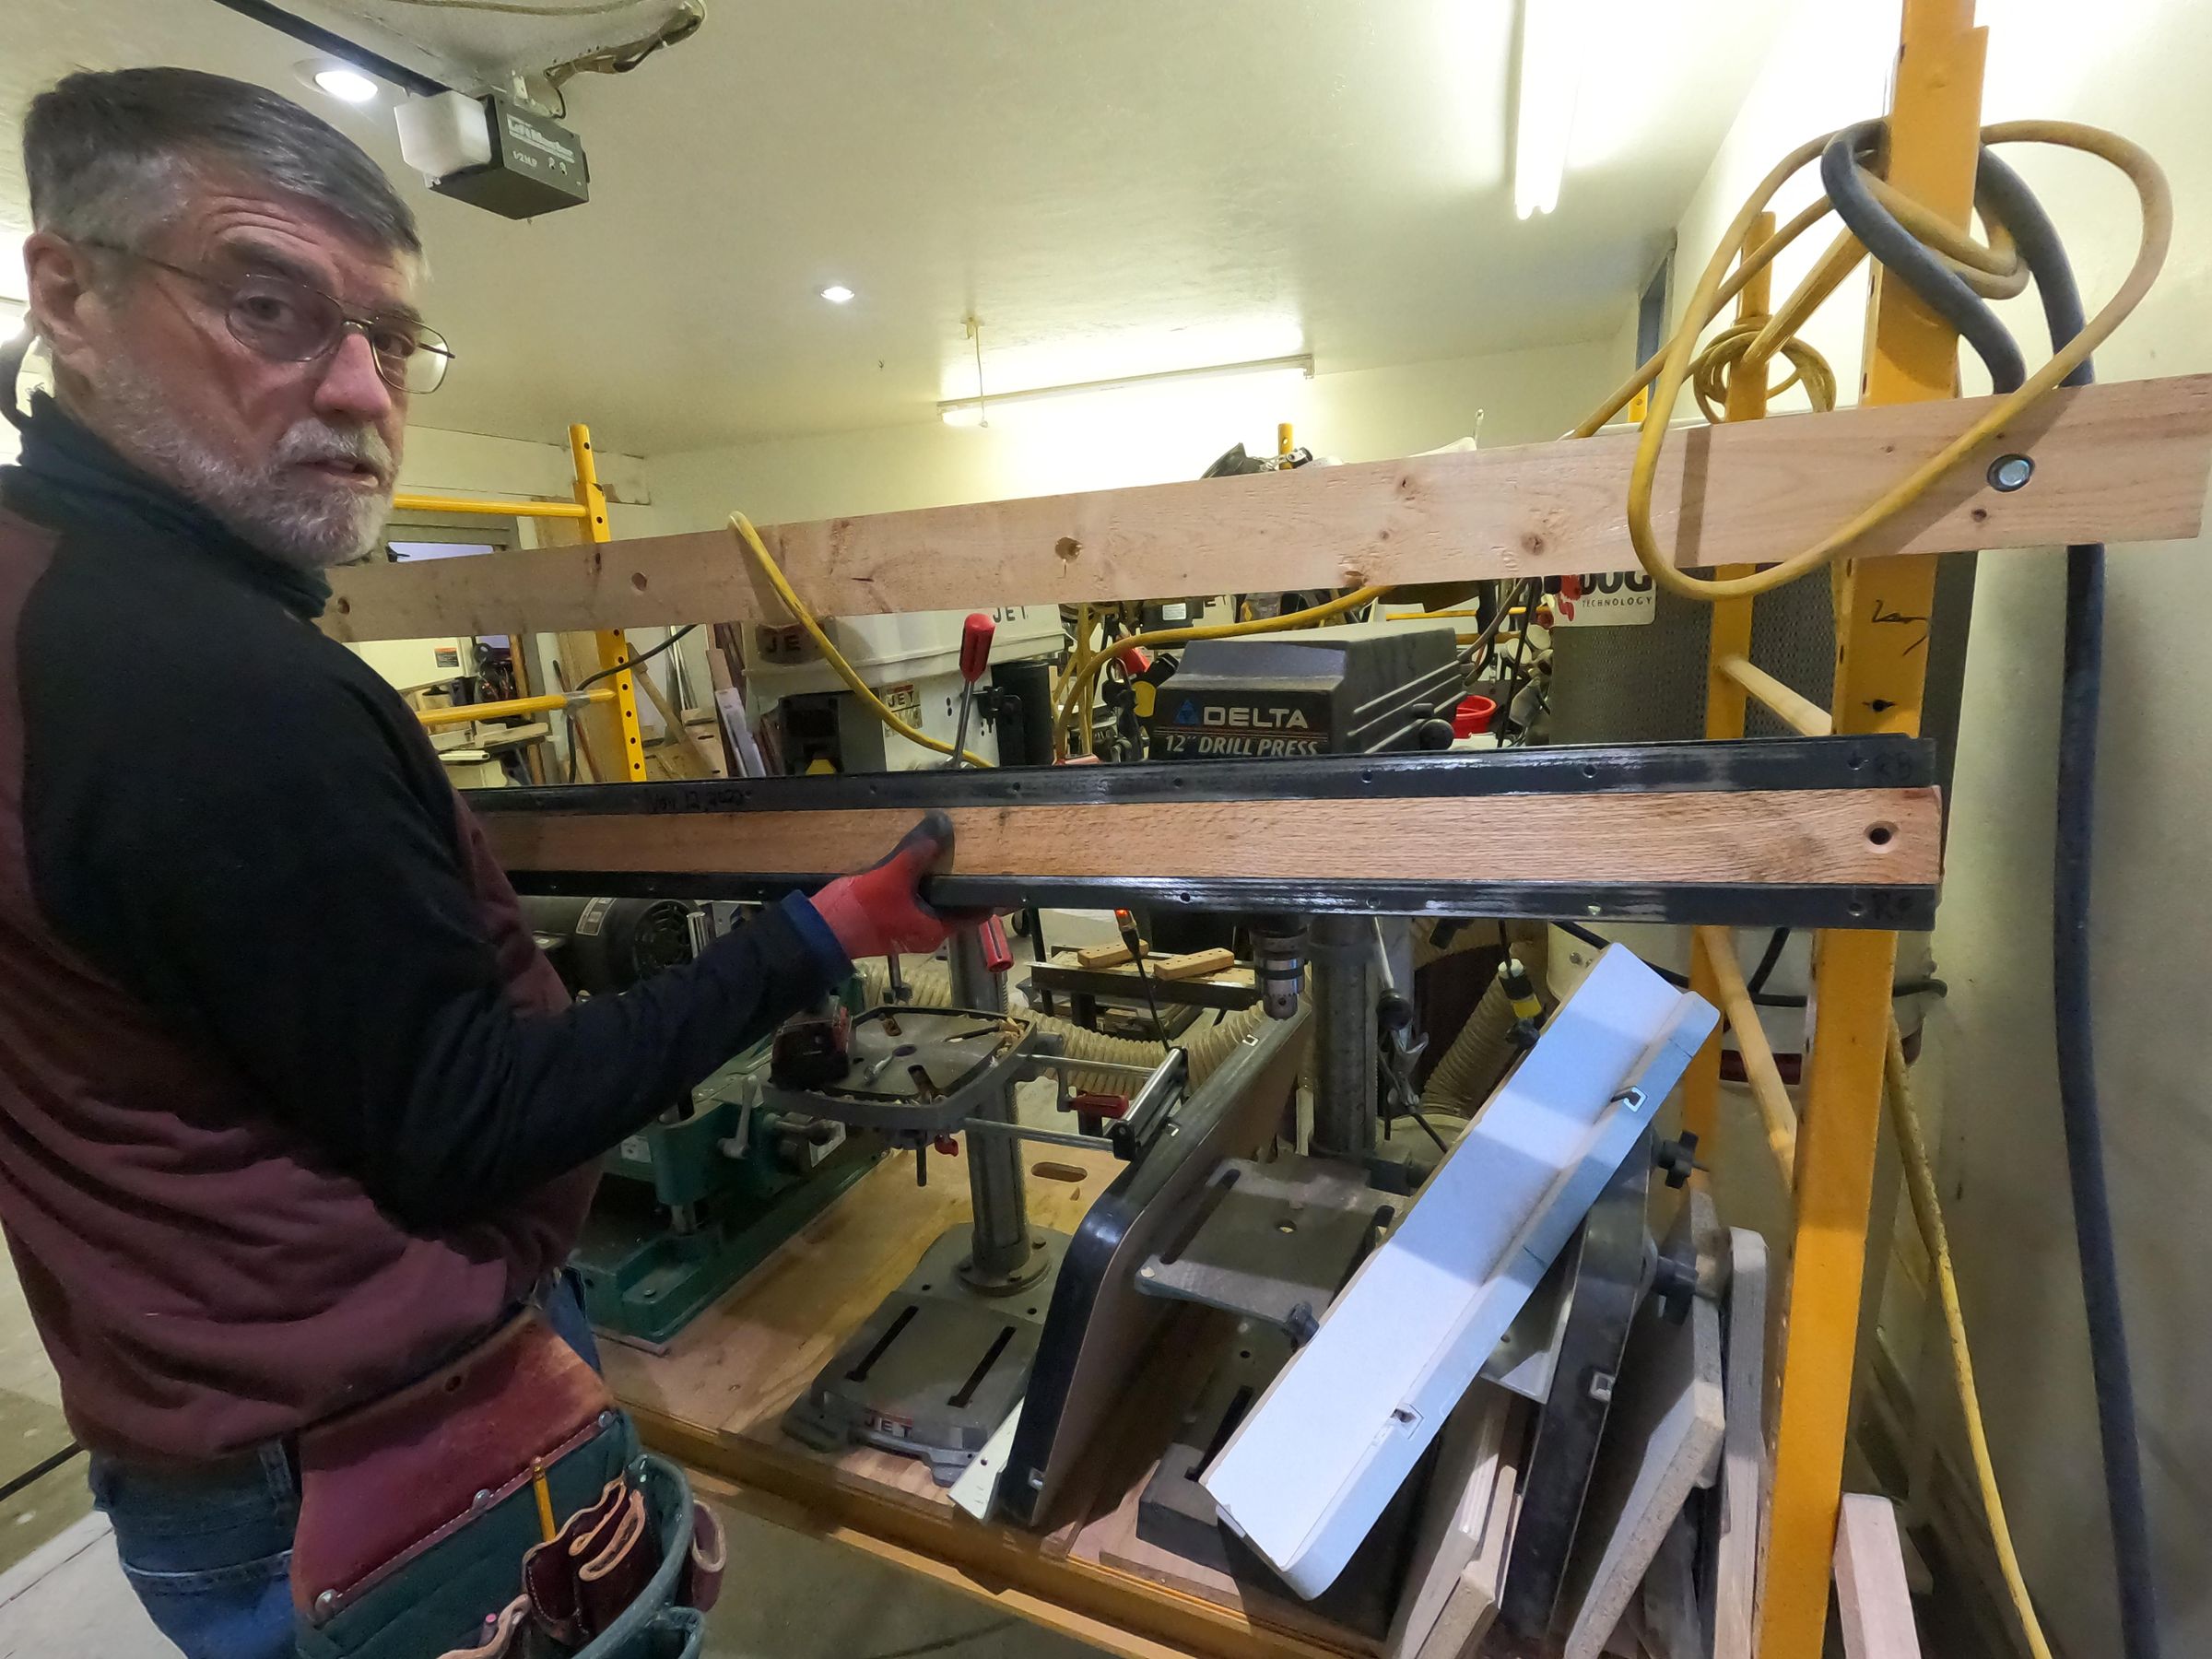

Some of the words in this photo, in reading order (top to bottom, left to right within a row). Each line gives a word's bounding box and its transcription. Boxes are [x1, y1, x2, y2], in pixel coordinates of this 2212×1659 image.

[1582, 596, 1653, 607] TECHNOLOGY
[888, 690, 914, 708] JET
[1203, 706, 1309, 729] DELTA
[1165, 735, 1197, 752] 12"
[1198, 736, 1253, 756] DRILL
[1256, 738, 1319, 757] PRESS
[865, 1415, 914, 1439] JET
